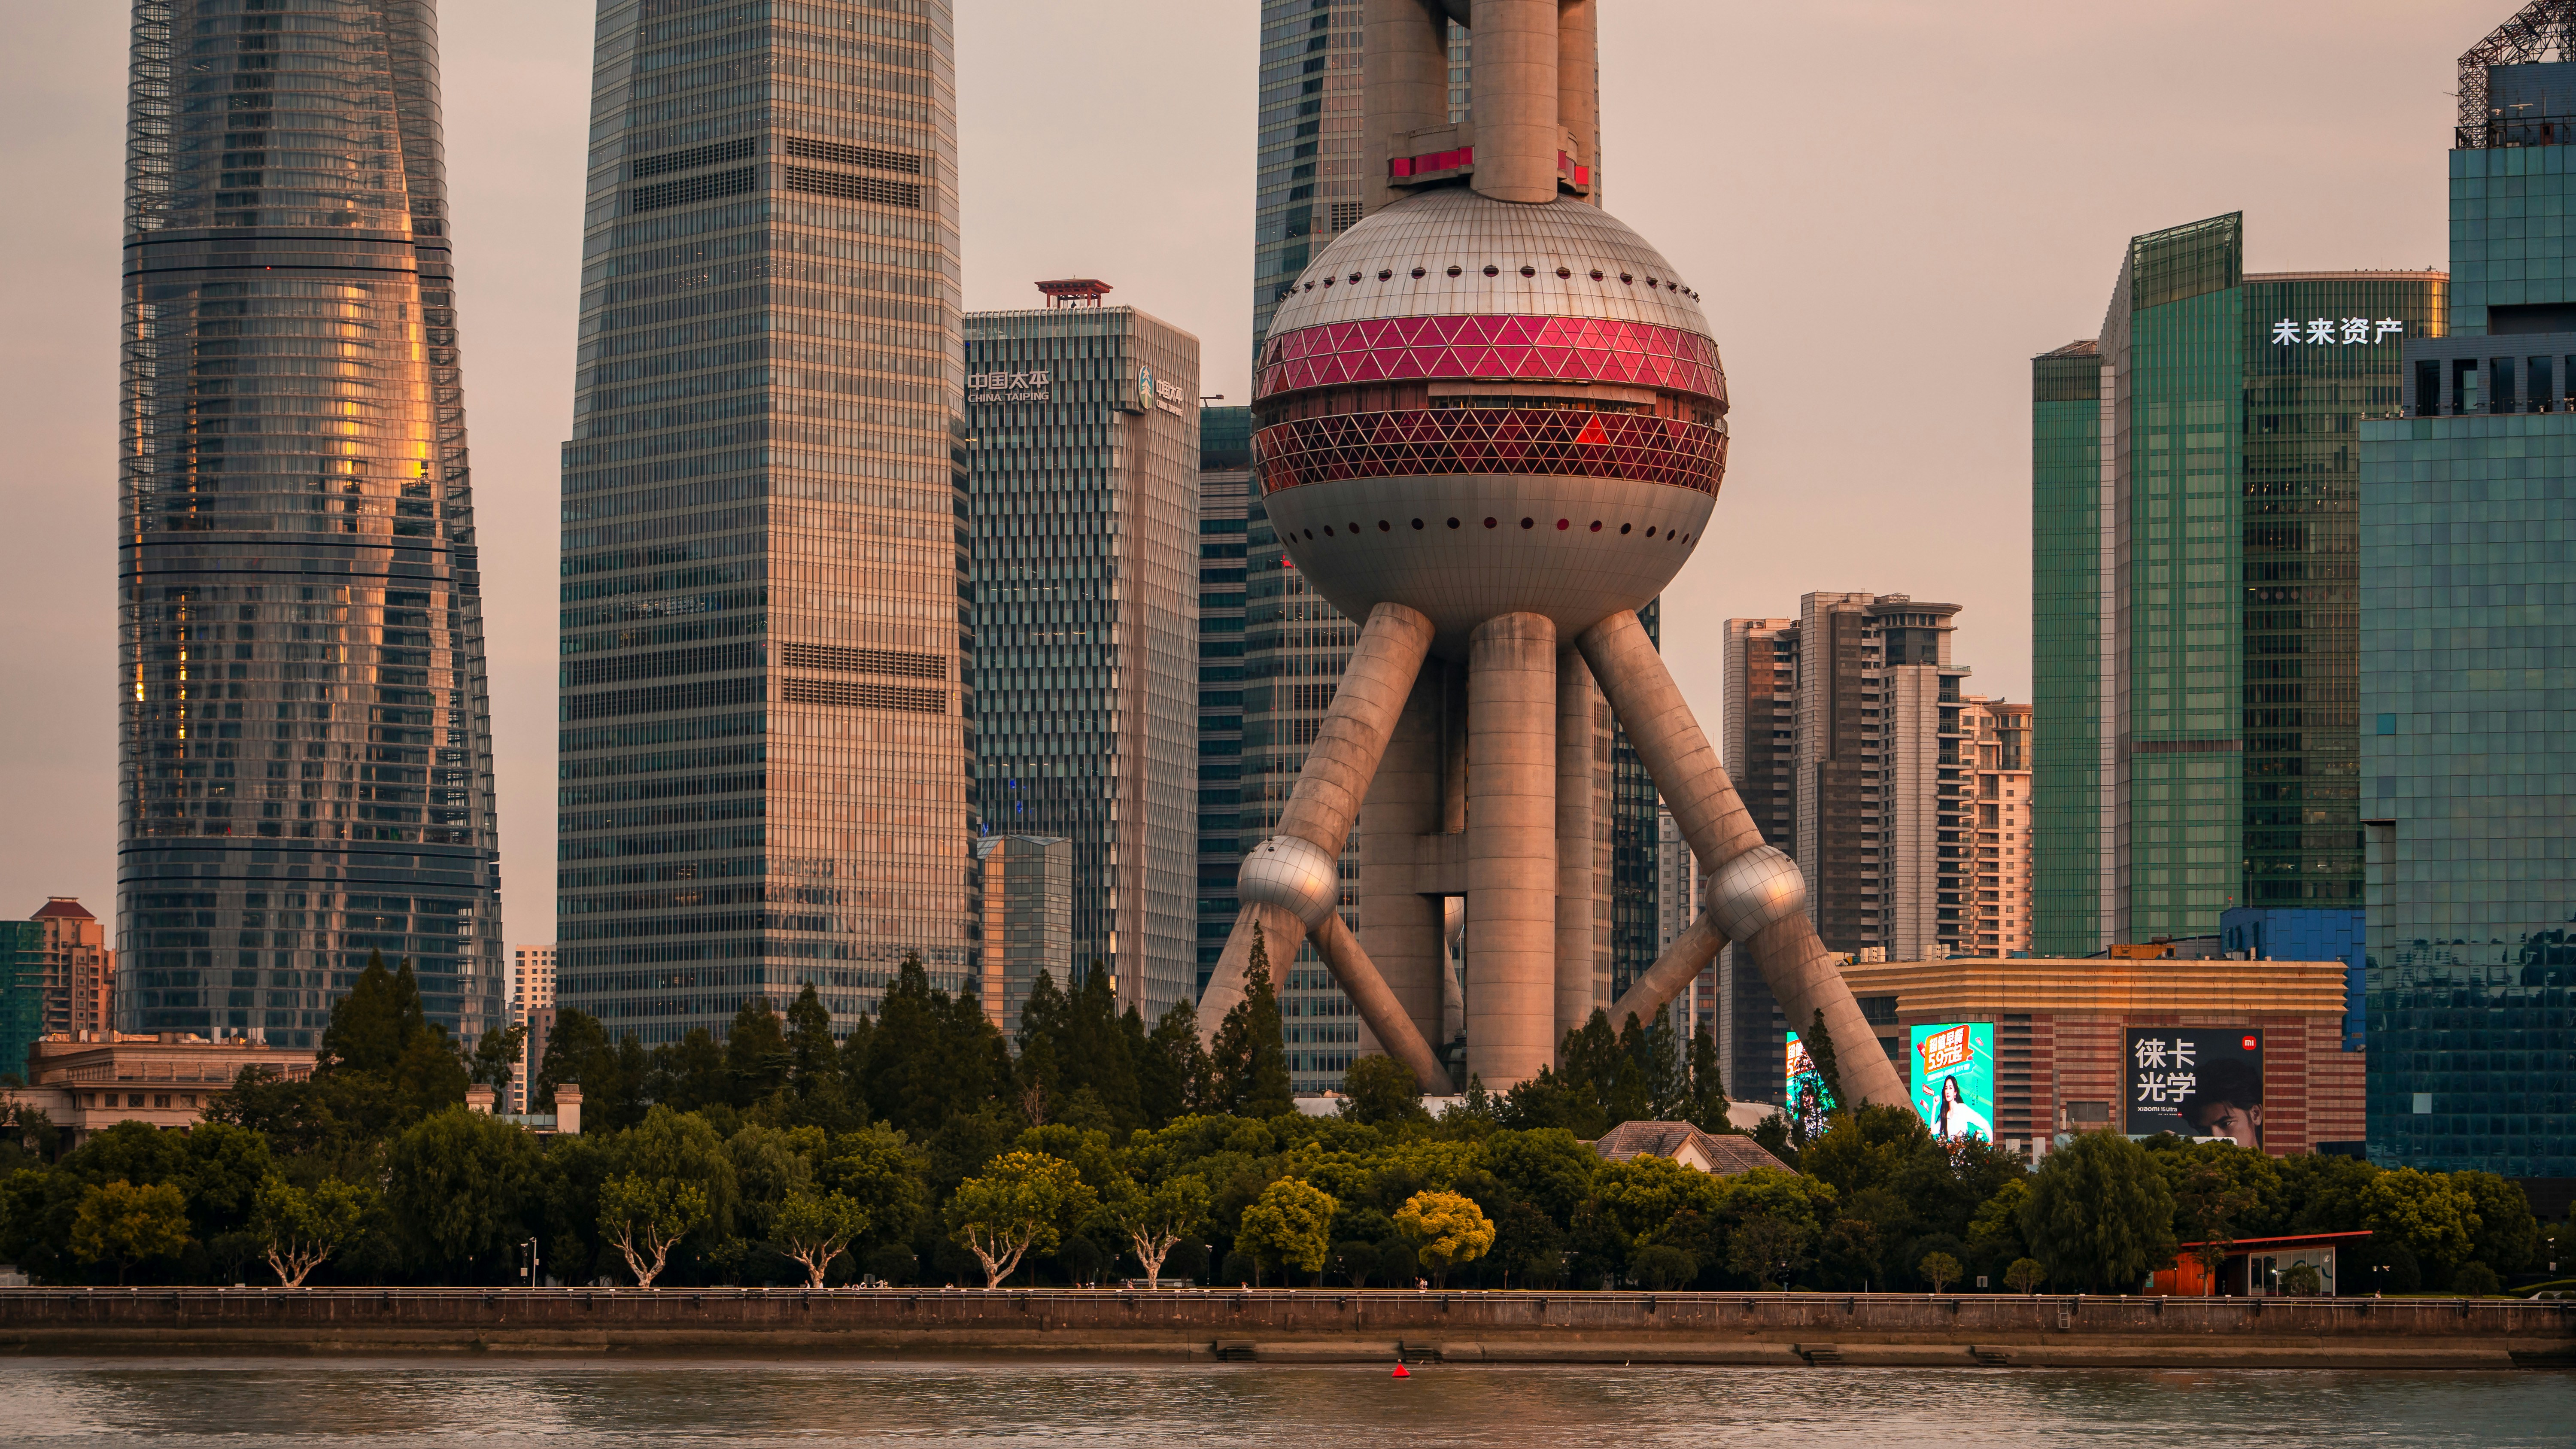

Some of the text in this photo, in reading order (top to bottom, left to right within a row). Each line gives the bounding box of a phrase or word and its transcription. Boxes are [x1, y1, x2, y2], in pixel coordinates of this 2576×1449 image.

[2272, 317, 2403, 345] 未来资产
[968, 371, 1049, 391] 中国太平
[1156, 378, 1182, 404] 中国太平
[968, 392, 1049, 403] CHINA TAIPING
[1929, 1027, 1964, 1054] 超值早餐
[2135, 1038, 2196, 1069] 徕卡
[1928, 1043, 1963, 1070] 5.9元起
[2137, 1072, 2196, 1102] 光学
